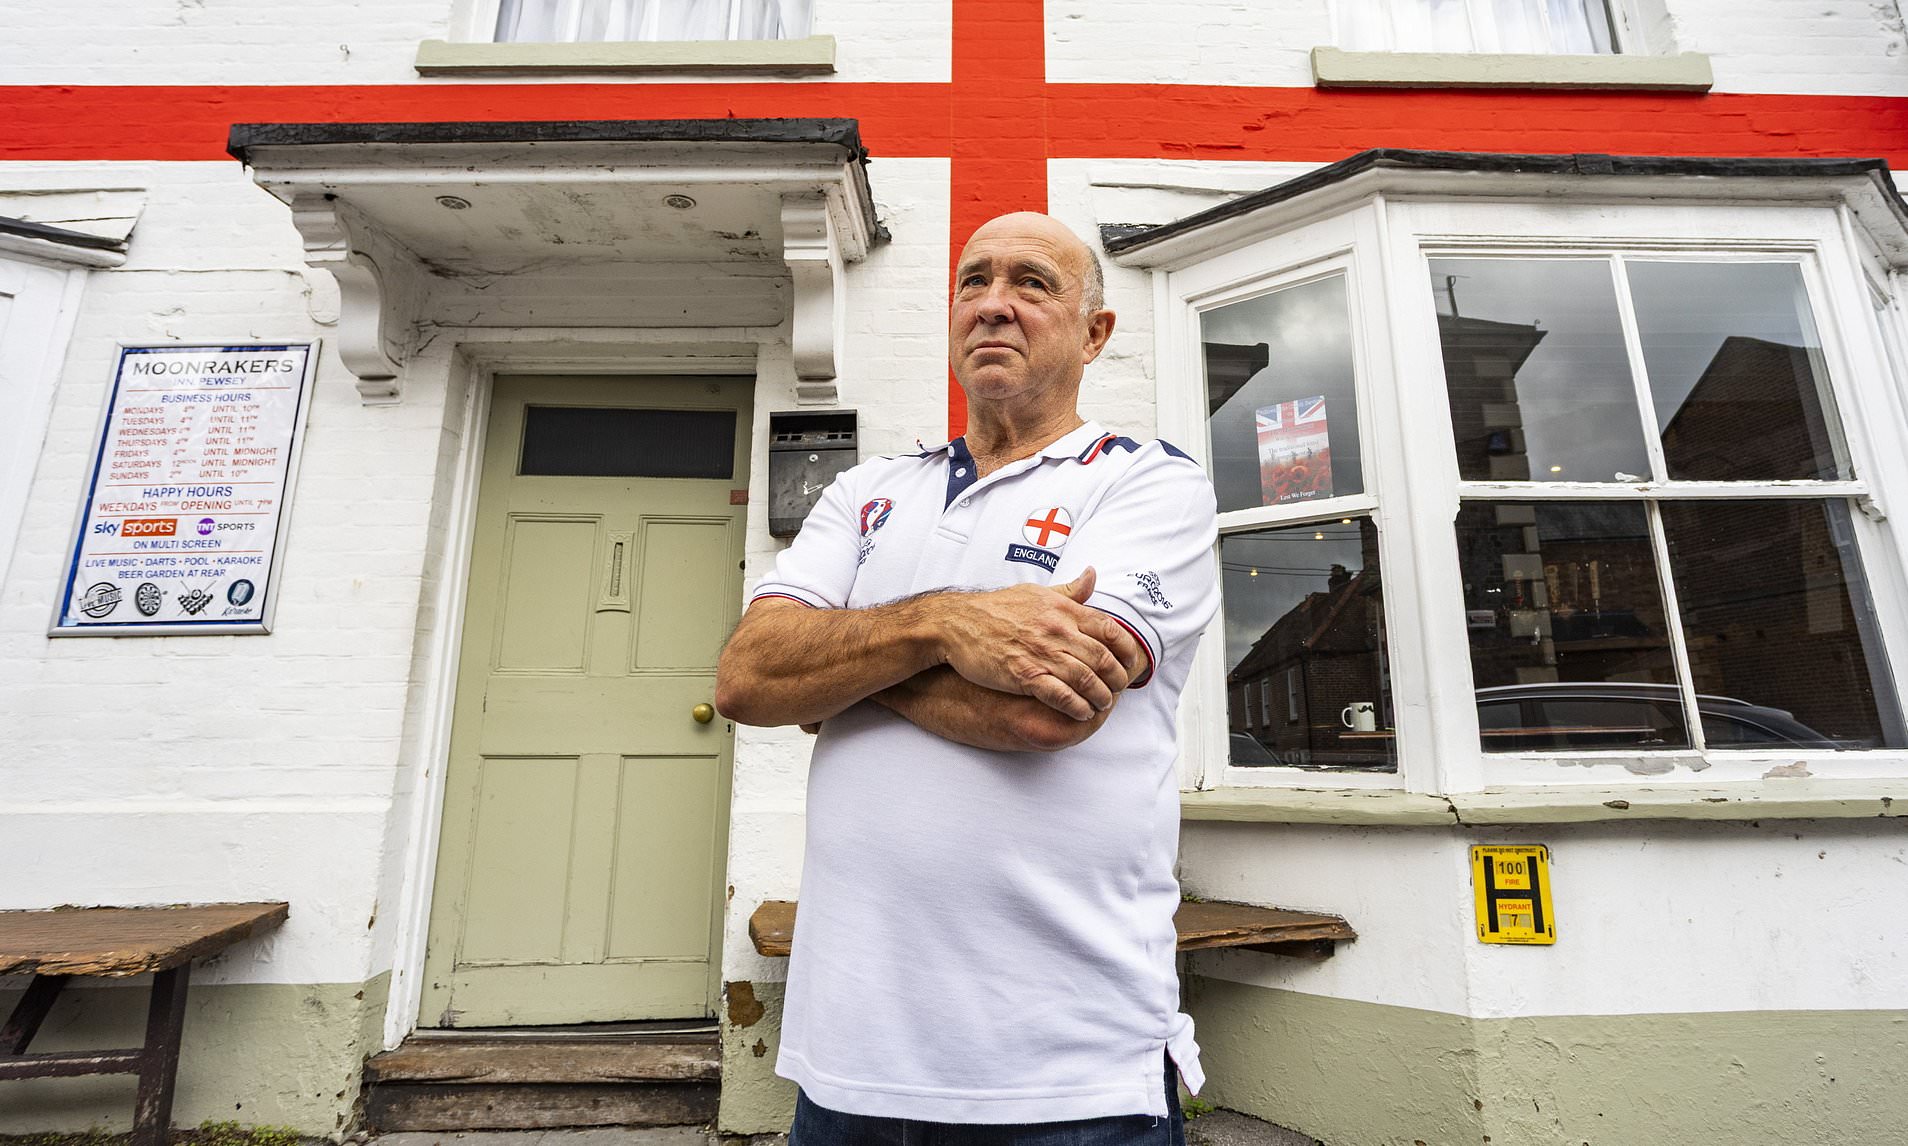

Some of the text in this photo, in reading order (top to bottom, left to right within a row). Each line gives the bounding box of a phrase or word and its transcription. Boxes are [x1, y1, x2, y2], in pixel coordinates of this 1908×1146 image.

[133, 360, 294, 376] MOONRAKERS
[200, 376, 247, 386] PEWSEY
[161, 393, 251, 404] BUSINESS HOURS
[124, 406, 165, 414] MONDAYS
[212, 405, 238, 413] UNTIL
[122, 417, 165, 425] TUESDAYS
[210, 415, 235, 423] UNTIL
[119, 427, 177, 436] WEDNESDAYS
[208, 426, 233, 434] UNTIL
[118, 438, 168, 447] THURSDAYS
[205, 437, 231, 445] UNTIL
[114, 449, 149, 458] FRIDAYS
[203, 448, 229, 456] UNTIL
[233, 447, 278, 455] MIDNIGHT
[111, 460, 162, 469] SATURDAYS
[201, 459, 226, 467] UNTIL
[231, 458, 277, 466] MIDNIGHT
[110, 471, 150, 480] SUNDAYS
[199, 470, 225, 478] UNTIL
[142, 486, 233, 498] HAPPY HOURS
[99, 501, 158, 512] WEEKDAYS
[180, 500, 232, 511] OPENING
[94, 520, 175, 536] sky sports
[217, 522, 255, 531] SPORTS
[133, 539, 222, 550] ON MULTI SCREEN
[85, 556, 263, 568] LIVE MUSIC DARTS POOL KARAOKE
[1013, 547, 1058, 569] ENGLAND
[118, 568, 227, 579] BEER GARDEN AT REAR
[1498, 861, 1523, 875] 100
[1511, 914, 1518, 926] 7
